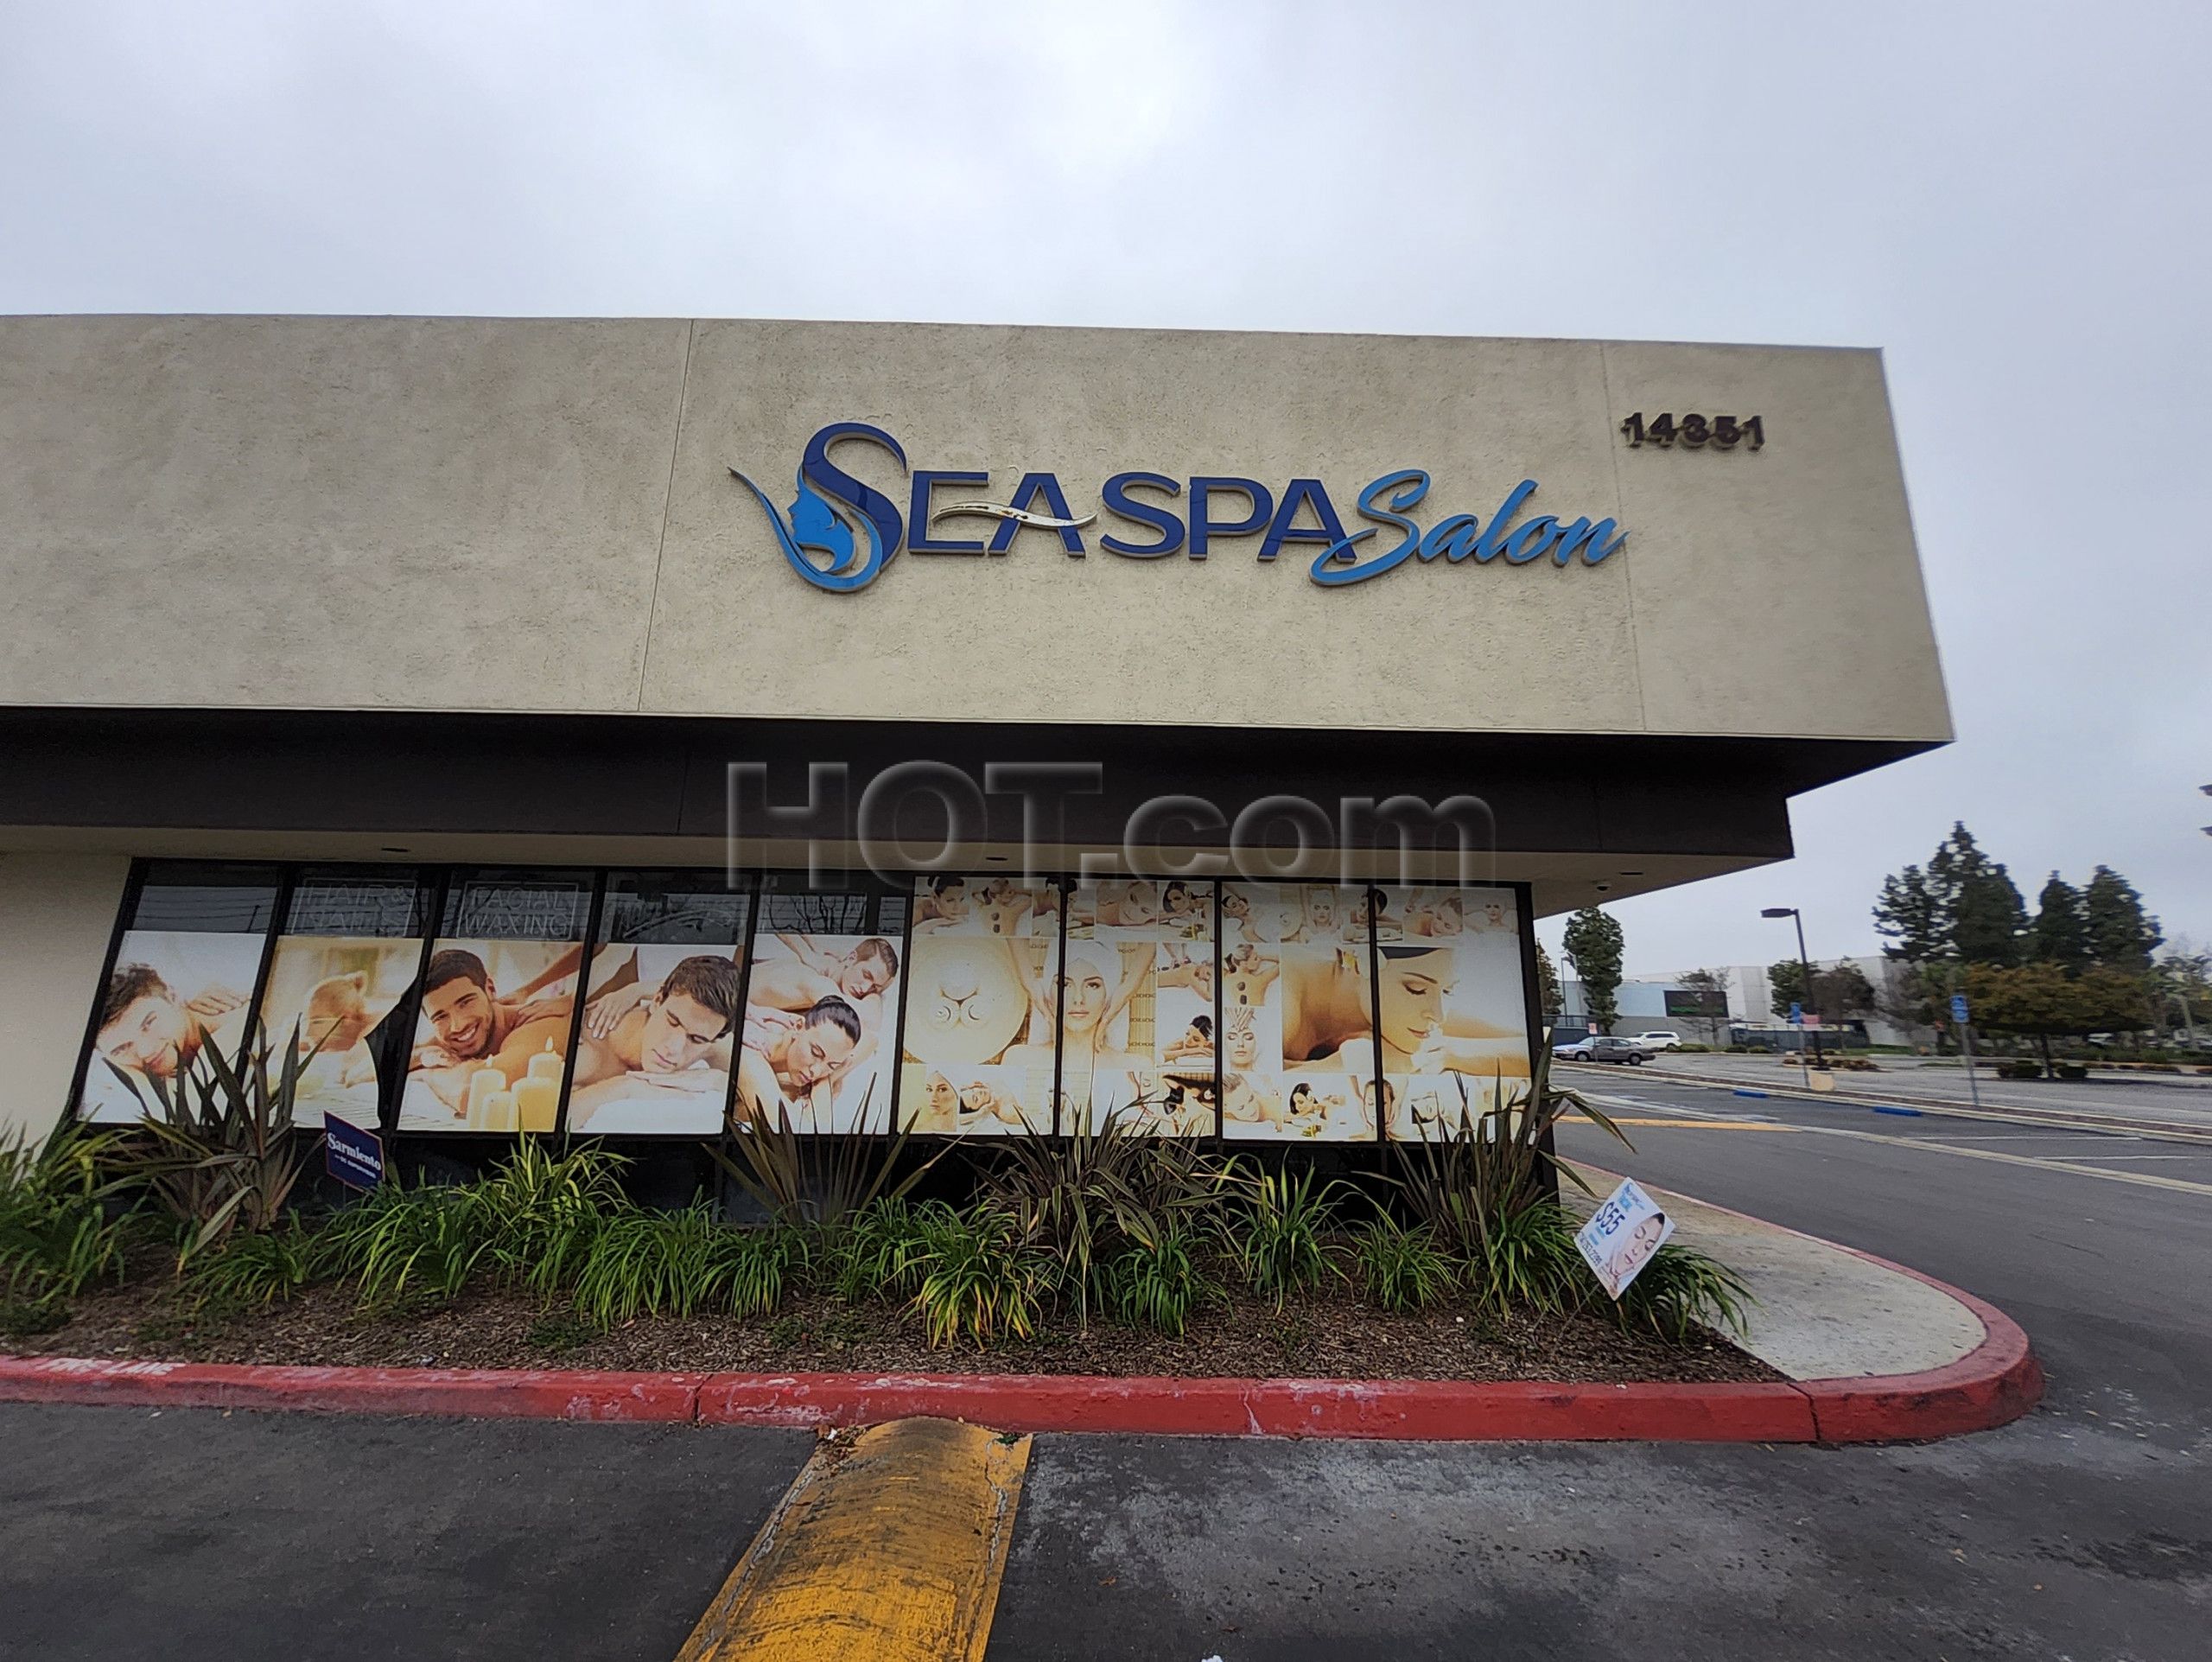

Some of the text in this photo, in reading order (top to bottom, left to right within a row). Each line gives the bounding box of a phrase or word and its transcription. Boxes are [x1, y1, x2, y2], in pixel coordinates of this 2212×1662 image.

[1309, 468, 1630, 586] Salon
[471, 887, 568, 910] FACIAL
[465, 914, 569, 936] WAXING
